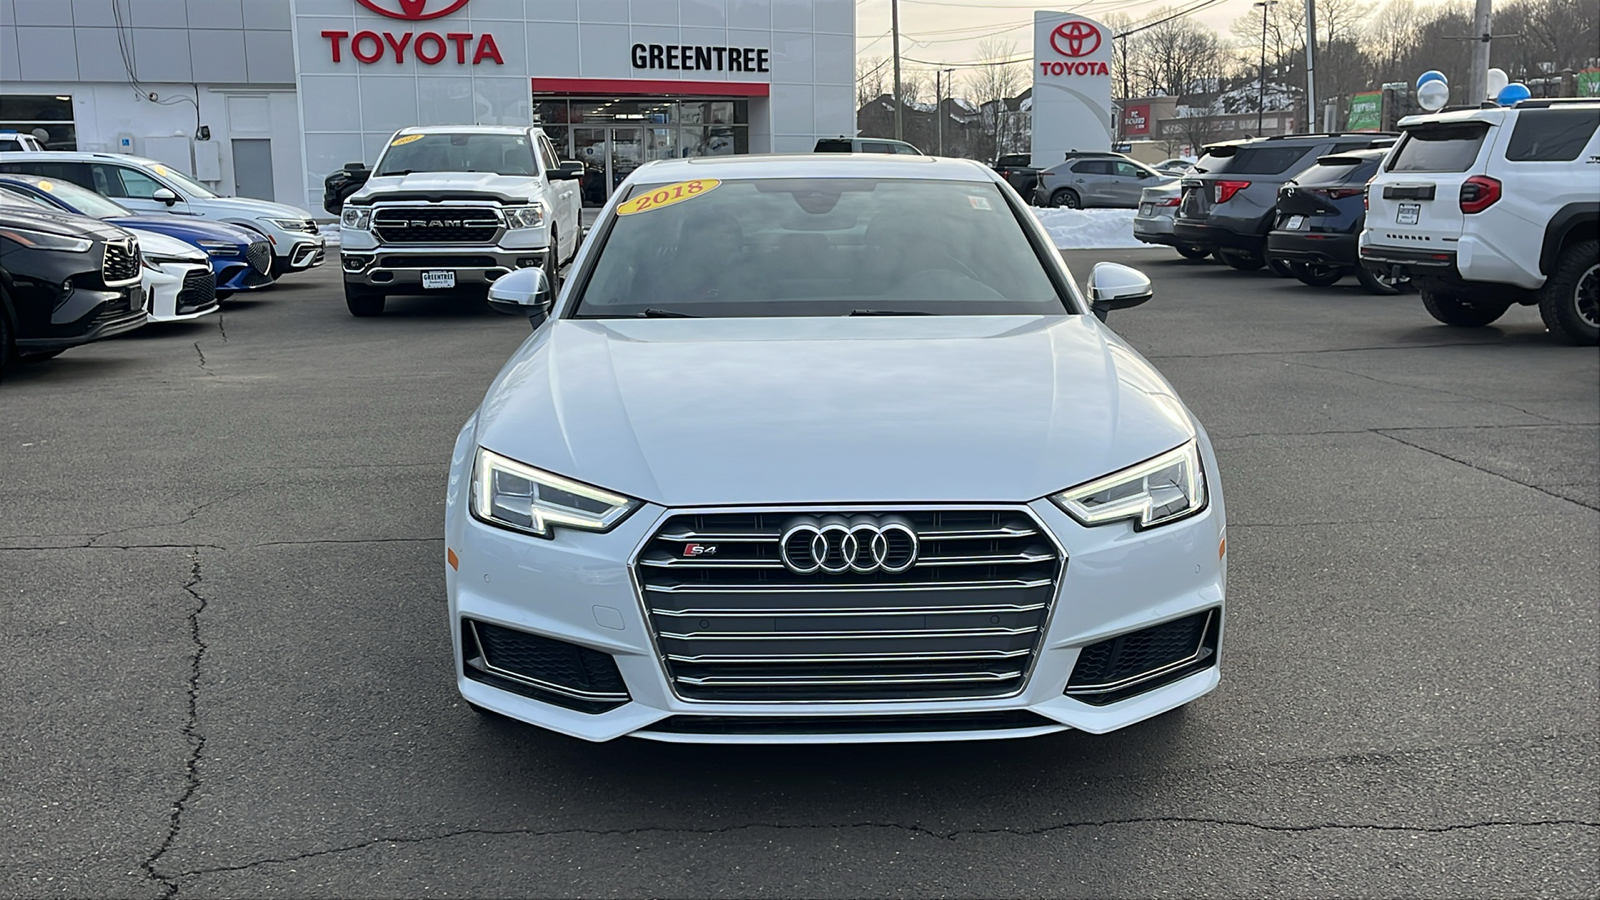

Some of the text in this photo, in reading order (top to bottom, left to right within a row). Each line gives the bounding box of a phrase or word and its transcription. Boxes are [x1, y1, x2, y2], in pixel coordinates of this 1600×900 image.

[321, 31, 504, 65] TOYOTA
[631, 43, 769, 72] GREENTREE
[1040, 62, 1109, 76] TOYOTA
[636, 180, 703, 211] 2018
[691, 546, 717, 555] S4
